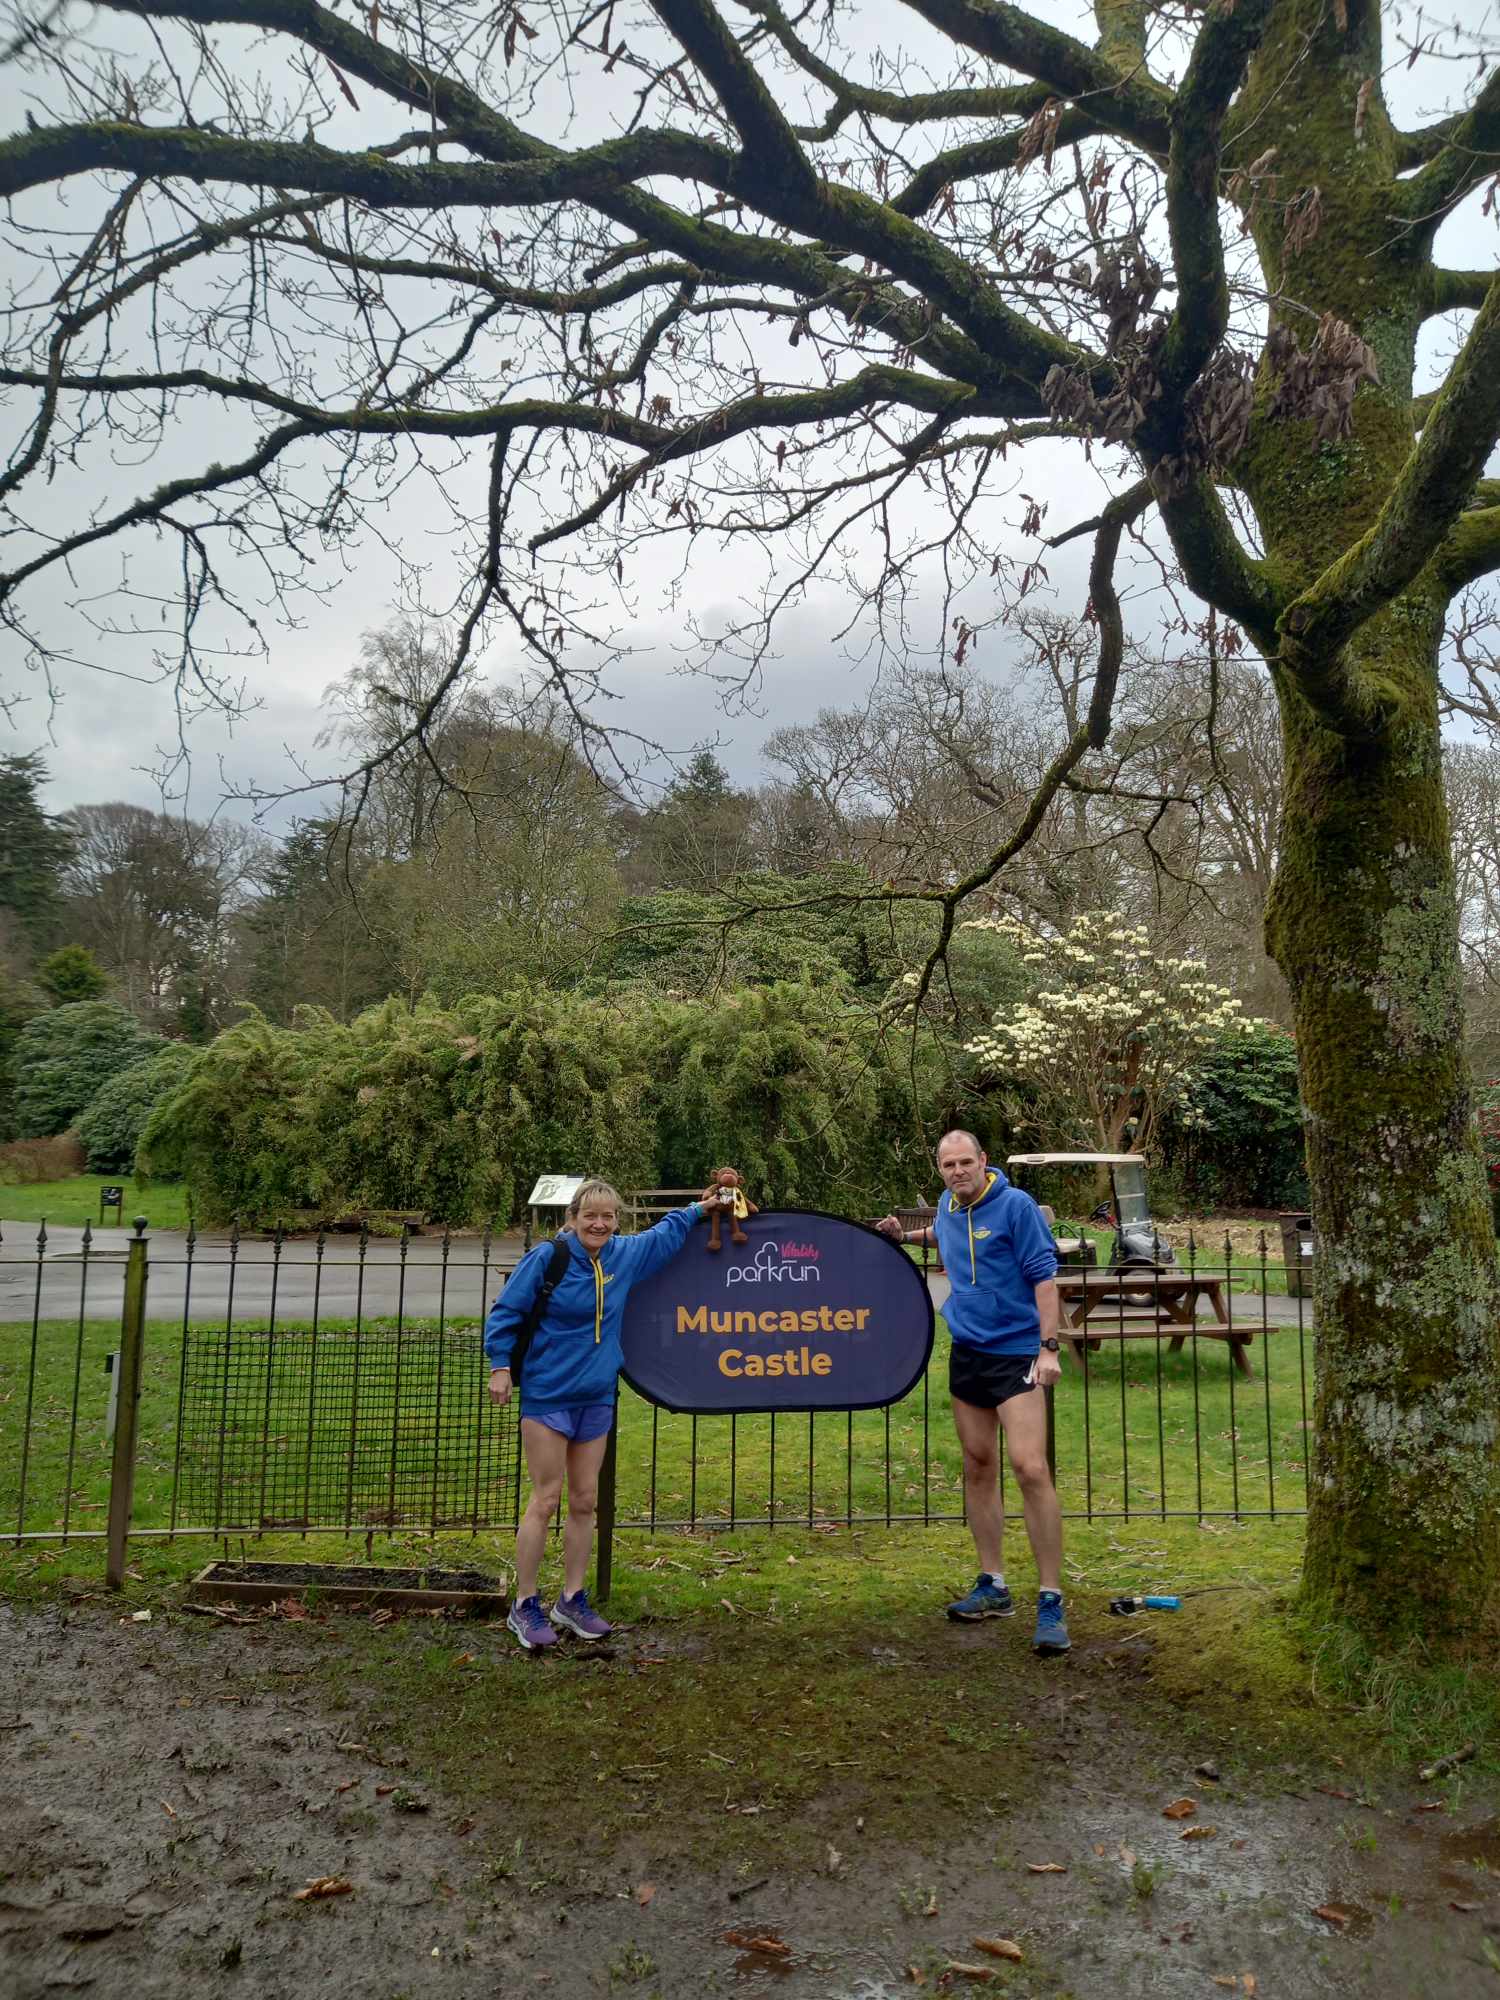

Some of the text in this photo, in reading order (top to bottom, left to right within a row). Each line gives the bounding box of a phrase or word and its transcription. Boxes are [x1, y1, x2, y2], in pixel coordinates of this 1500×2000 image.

[780, 1241, 818, 1263] Vitality
[726, 1253, 820, 1287] parkrun
[676, 1305, 870, 1333] Muncaster
[718, 1347, 833, 1377] Castle
